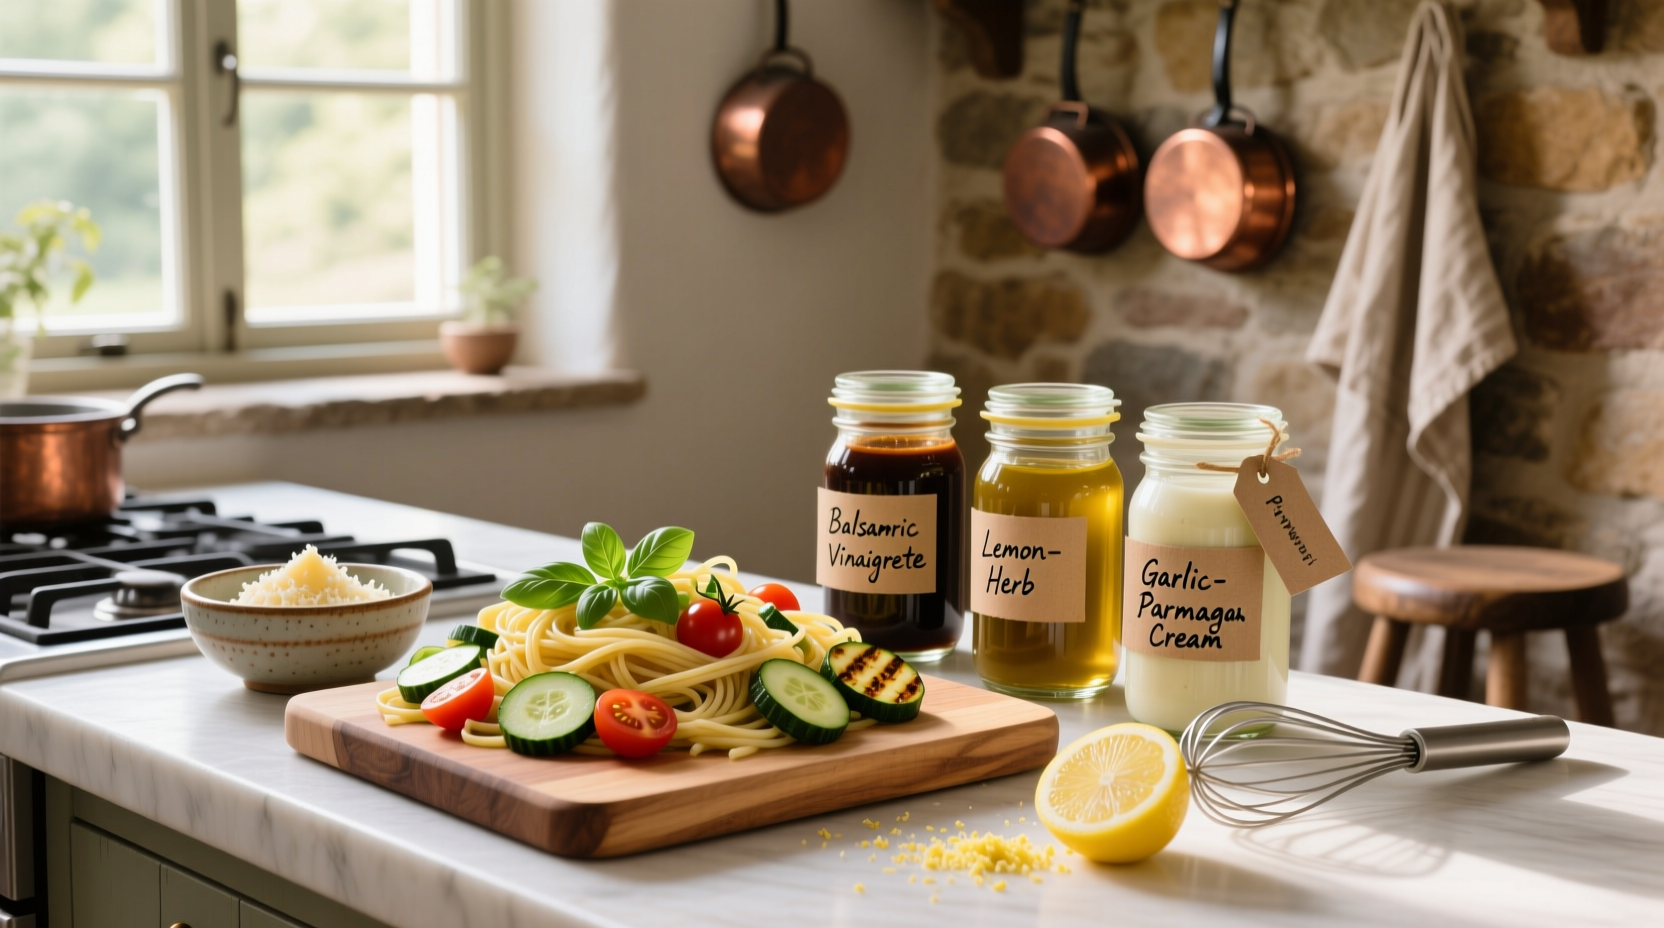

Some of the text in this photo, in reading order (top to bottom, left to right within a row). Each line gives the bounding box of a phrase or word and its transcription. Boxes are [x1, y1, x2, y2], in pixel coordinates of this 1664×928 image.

[982, 528, 1062, 560] Lemon-
[828, 542, 927, 584] Vinaigrete
[1141, 558, 1227, 591] Garlic-
[986, 564, 1035, 596] Herb
[1149, 622, 1223, 649] Cream
